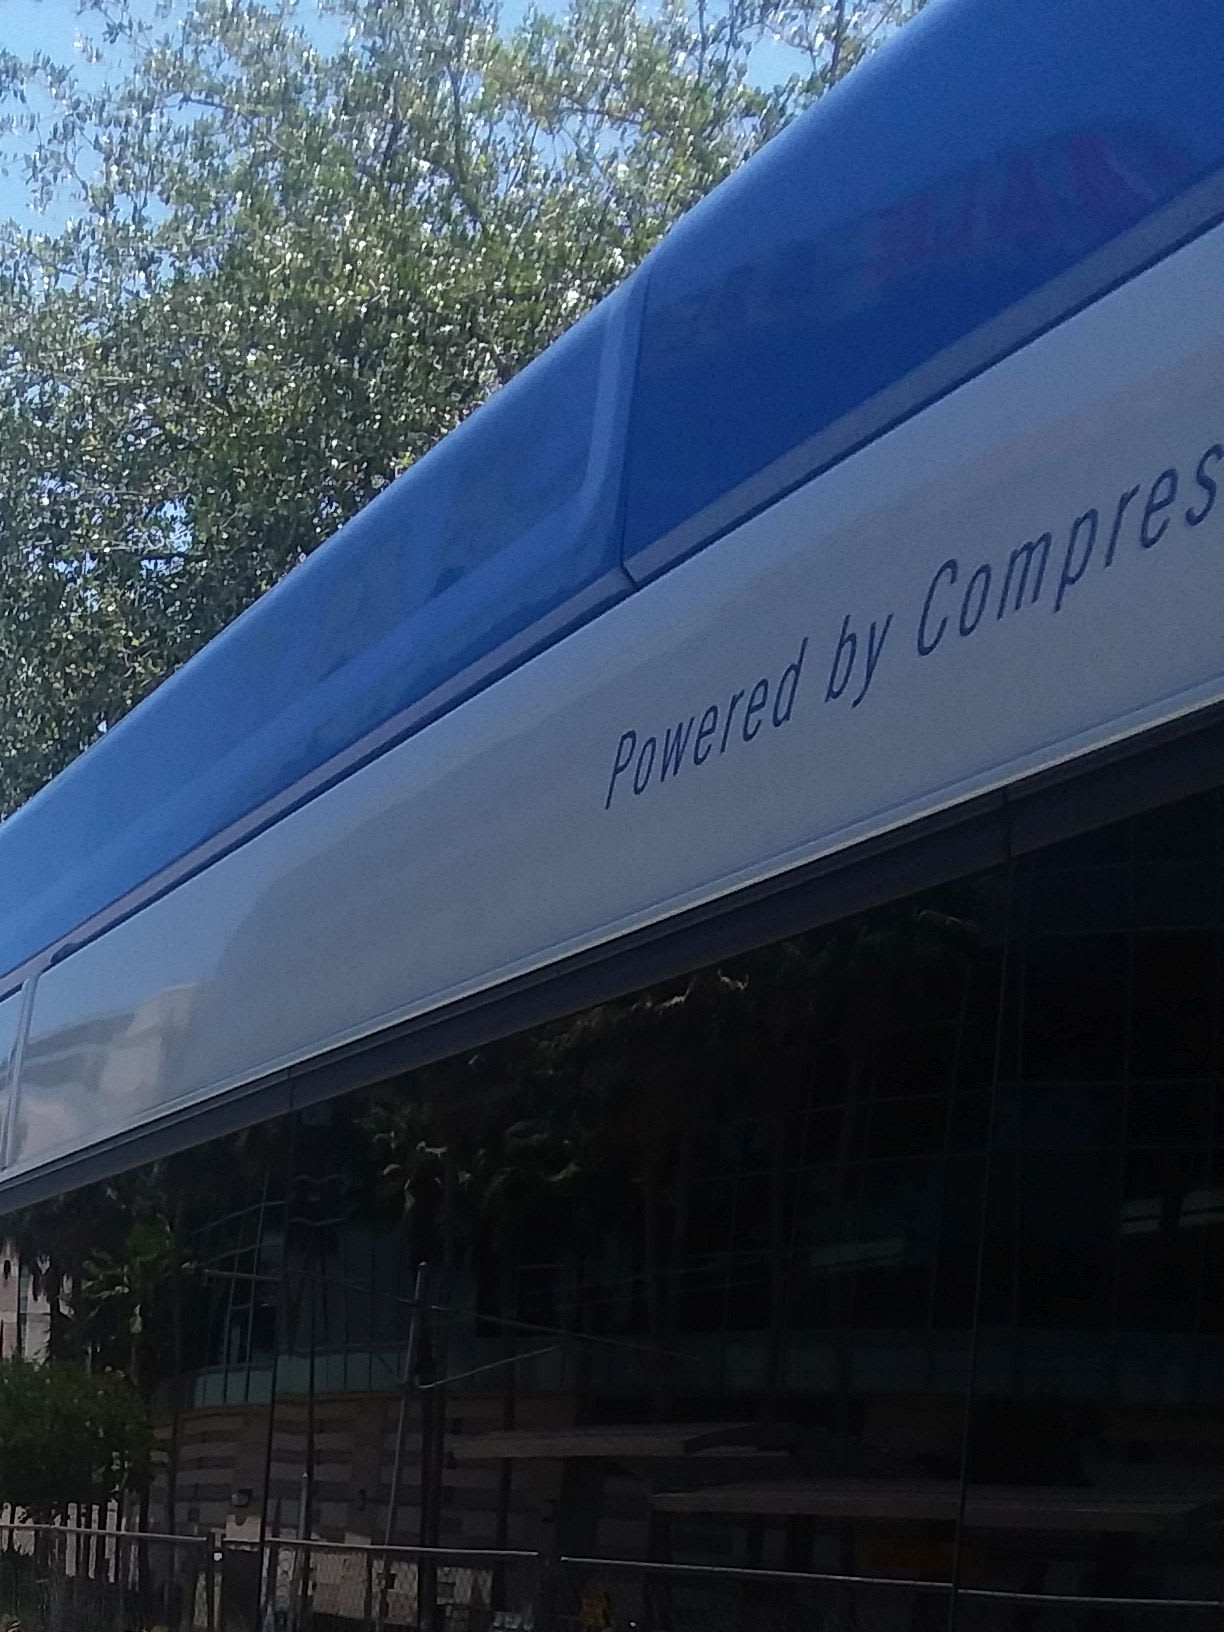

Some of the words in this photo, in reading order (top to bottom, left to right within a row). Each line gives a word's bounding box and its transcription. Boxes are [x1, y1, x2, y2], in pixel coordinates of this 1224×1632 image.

[604, 636, 809, 811] Powered
[824, 613, 894, 709] by
[916, 442, 1224, 656] Compres
